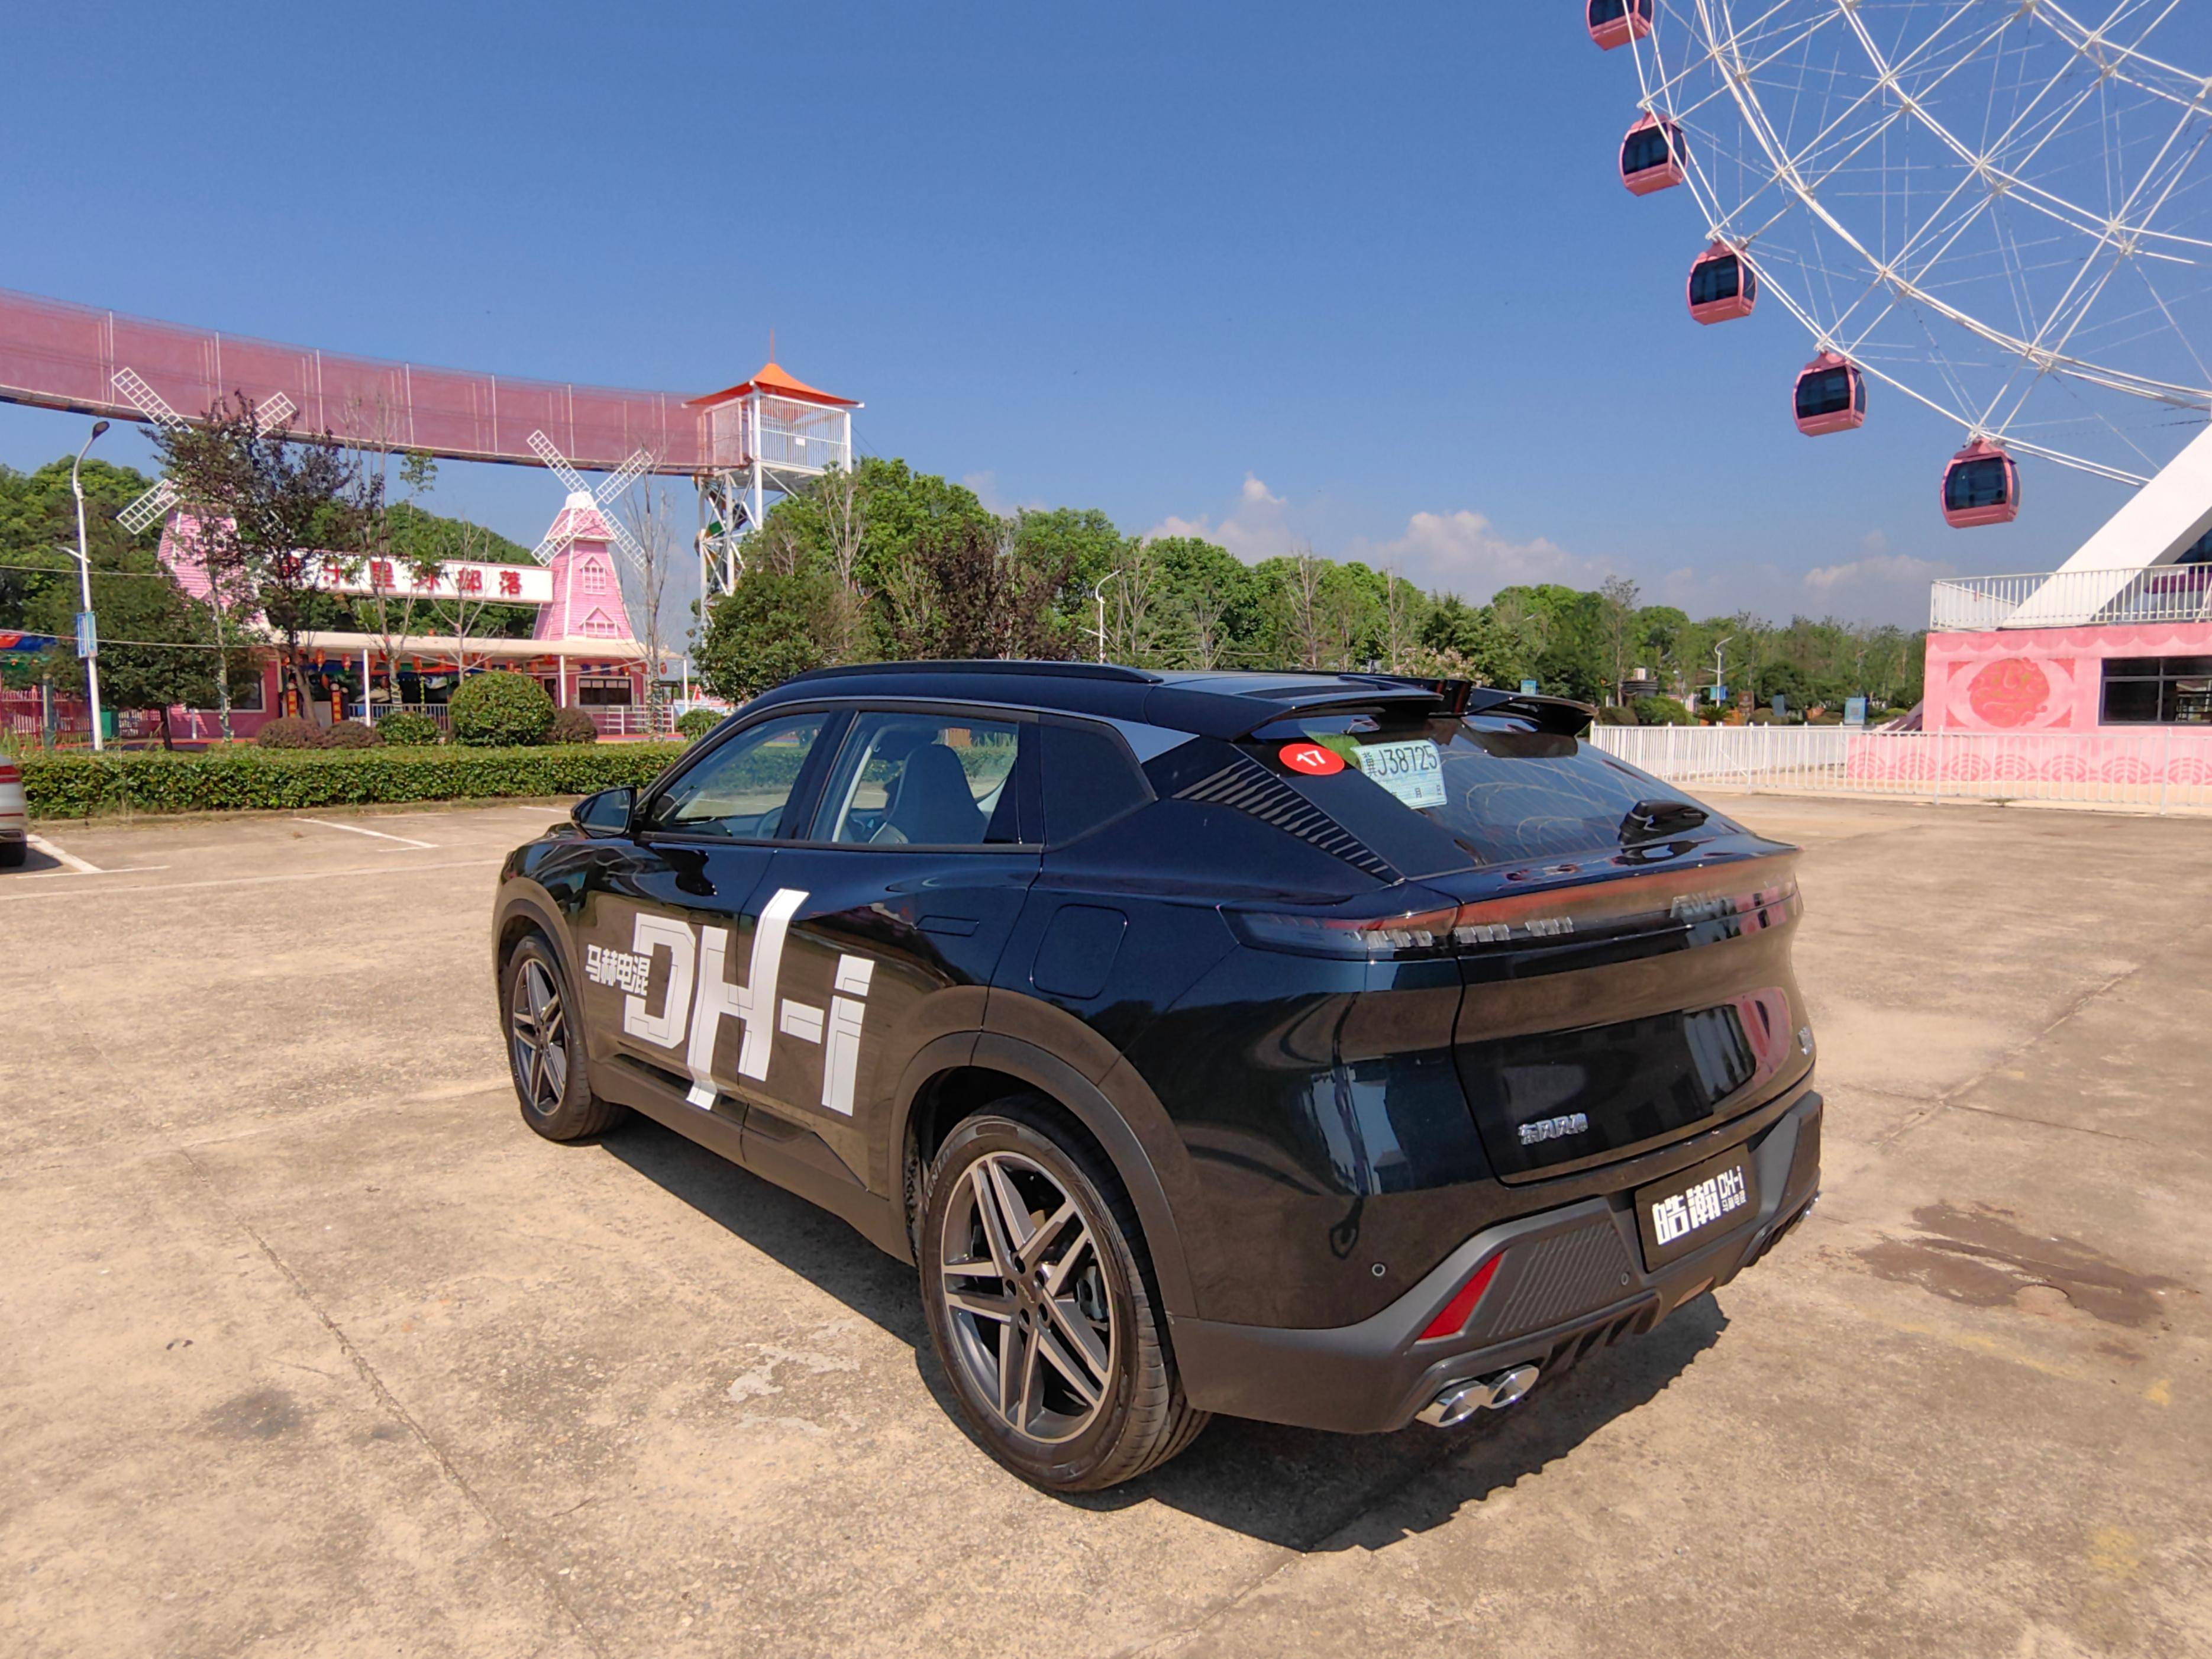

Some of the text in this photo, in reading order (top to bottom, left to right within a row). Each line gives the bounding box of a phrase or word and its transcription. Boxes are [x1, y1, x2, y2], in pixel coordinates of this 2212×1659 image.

[1297, 750, 1326, 767] 17
[586, 944, 650, 996] 马赫电混
[1652, 1178, 1721, 1245] 皓瀚
